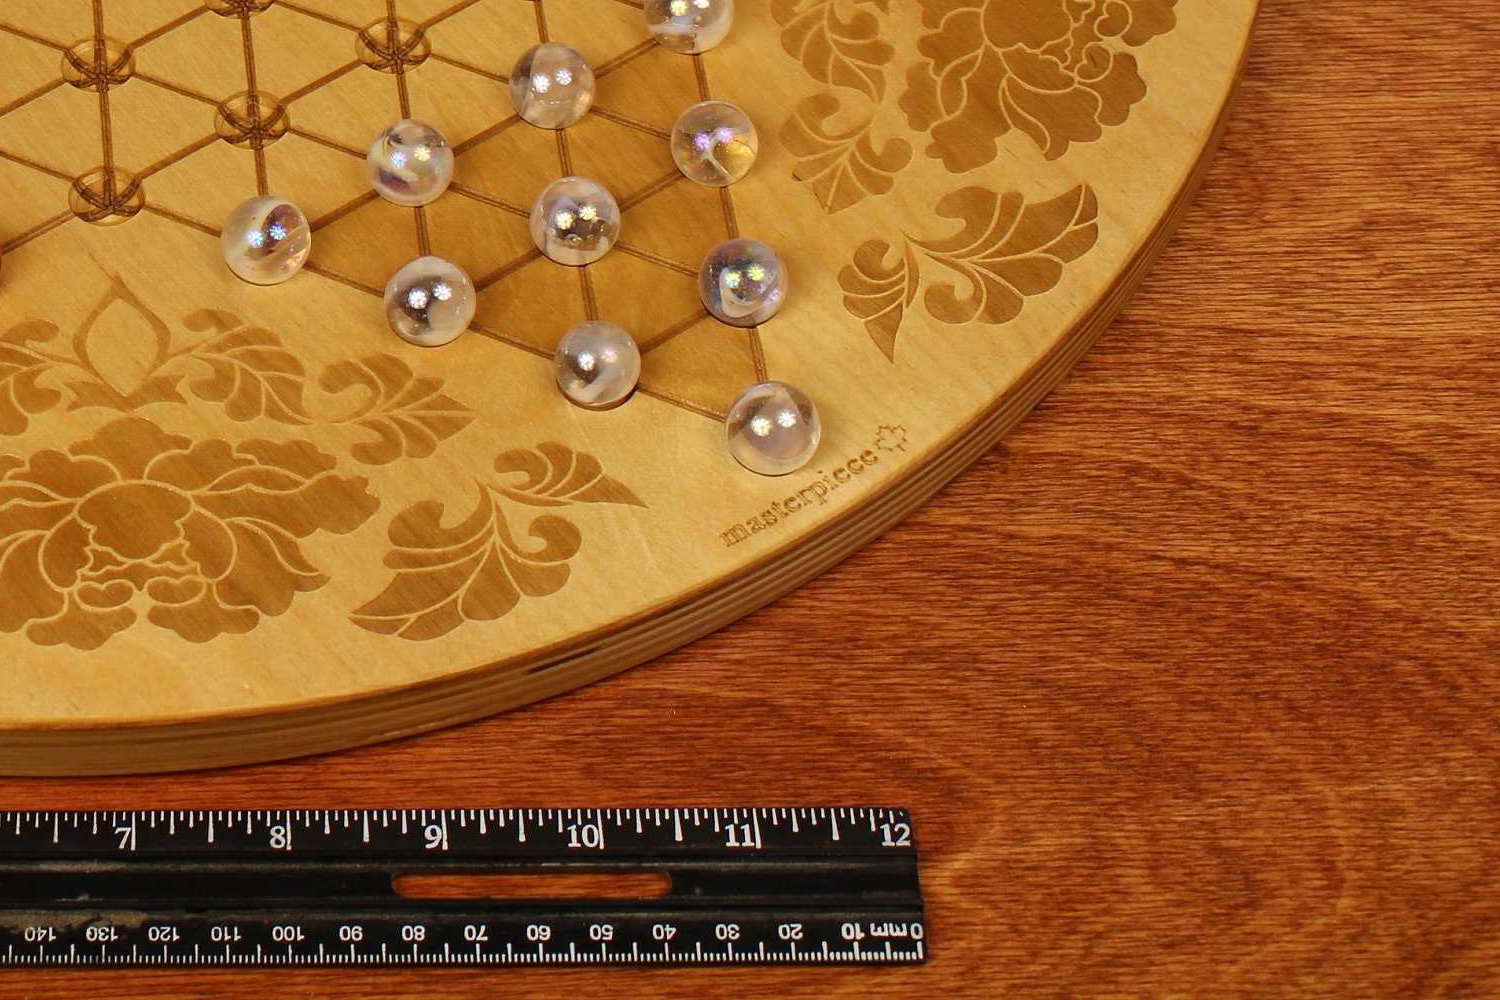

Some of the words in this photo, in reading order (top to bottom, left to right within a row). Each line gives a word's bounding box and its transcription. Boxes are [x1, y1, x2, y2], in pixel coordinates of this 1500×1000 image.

[720, 450, 878, 547] masterpiece
[114, 826, 132, 849] 7
[269, 825, 287, 848] 8
[424, 824, 444, 849] 9
[567, 824, 599, 848] 10
[725, 823, 755, 848] 11
[881, 823, 911, 848] 12
[24, 924, 57, 942] 140
[85, 924, 119, 942] 130
[148, 924, 180, 942] 120
[210, 924, 241, 942] 110
[272, 924, 305, 942] 100
[339, 924, 363, 942] 90
[401, 924, 425, 942] 80
[464, 924, 488, 941] 70
[526, 924, 551, 941] 60
[590, 924, 614, 941] 50
[652, 924, 677, 941] 40
[715, 924, 740, 941] 30
[778, 924, 802, 941] 20
[841, 922, 865, 940] 10
[870, 924, 908, 938] mm
[910, 923, 924, 941] 0
